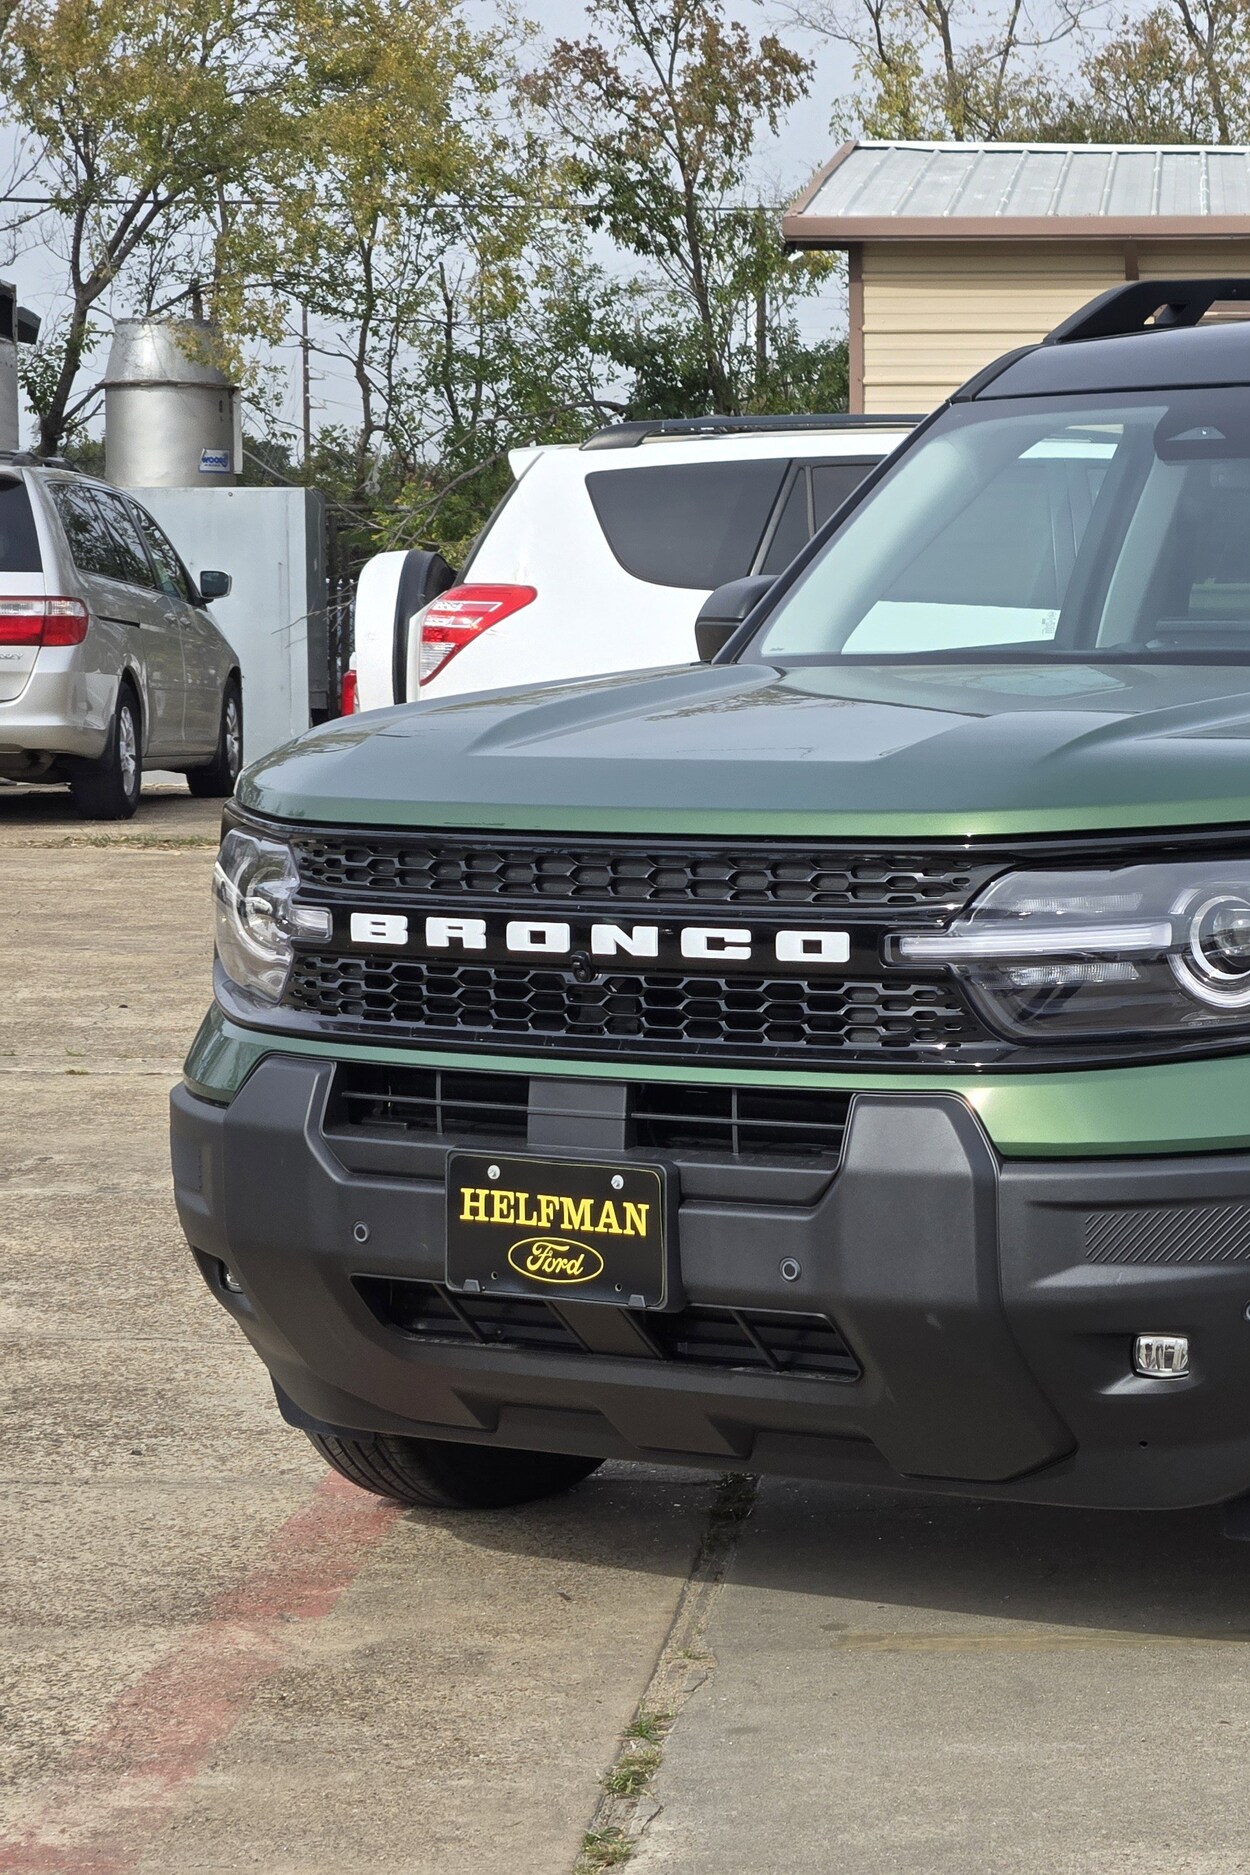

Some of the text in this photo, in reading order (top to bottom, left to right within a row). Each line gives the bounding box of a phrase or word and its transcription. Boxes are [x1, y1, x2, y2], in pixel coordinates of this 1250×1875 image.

[350, 912, 850, 963] BRONCO
[459, 1187, 650, 1237] HELFMAN
[526, 1241, 585, 1275] Ford
